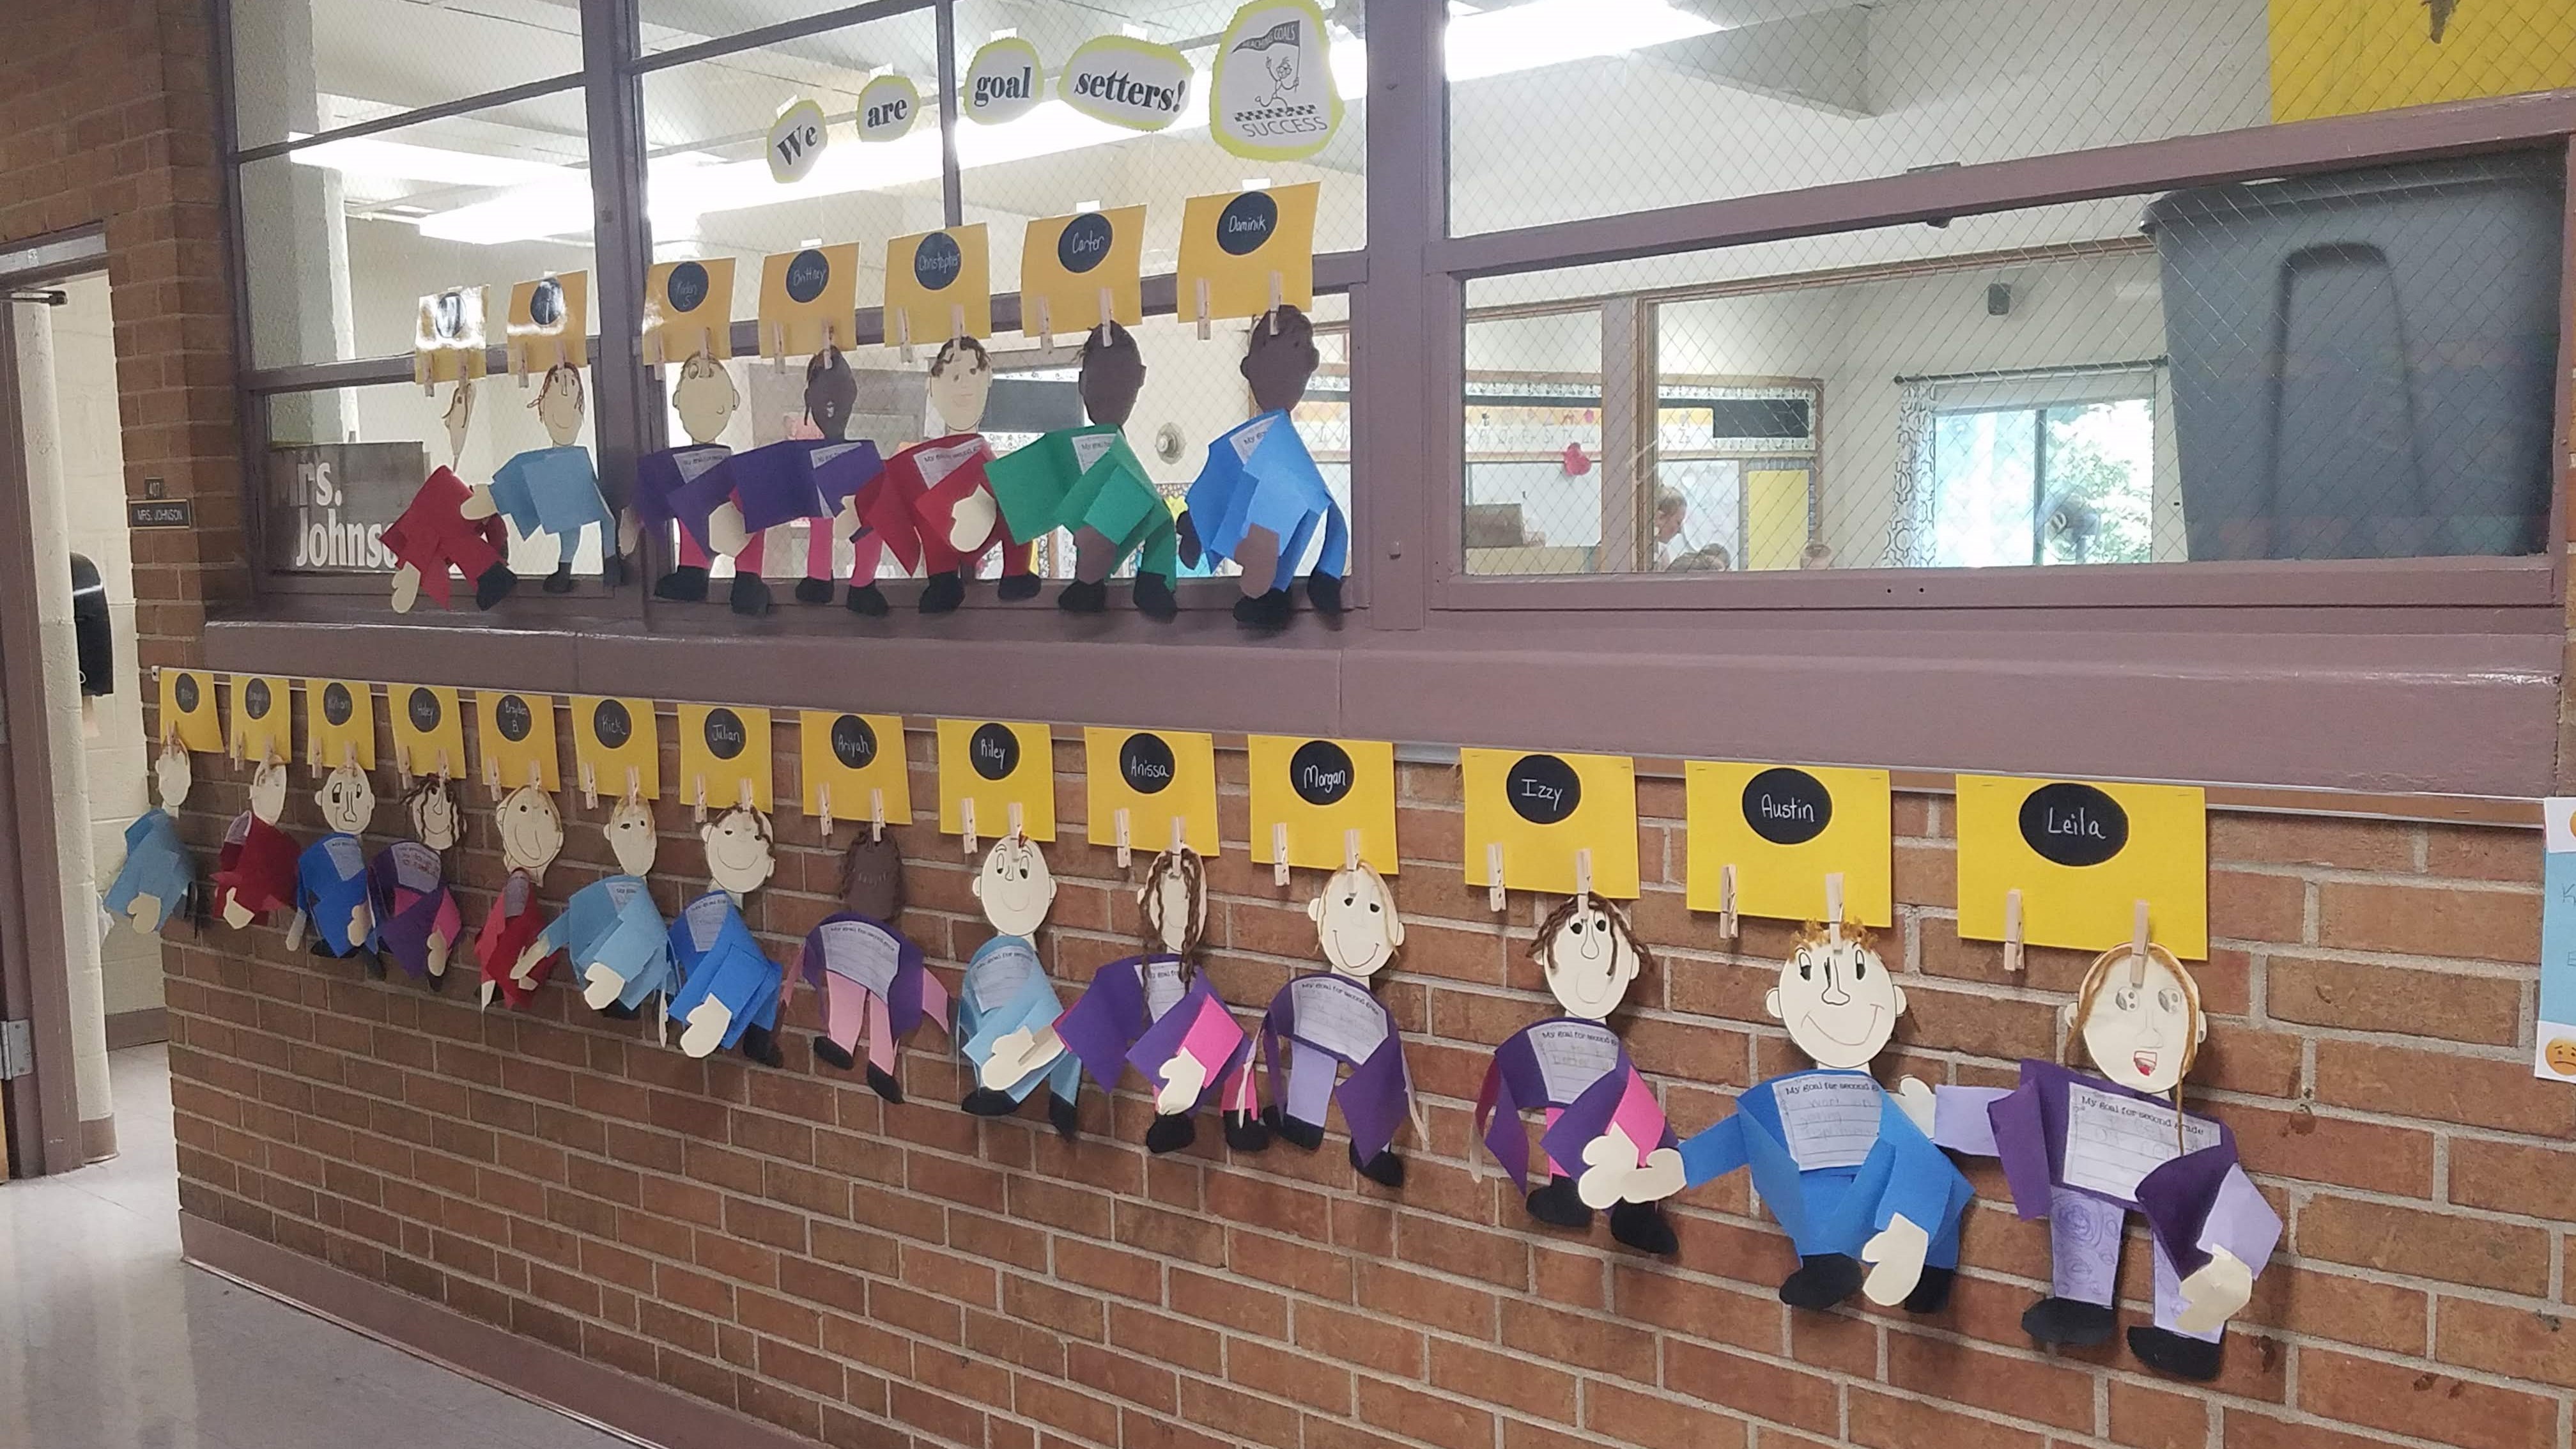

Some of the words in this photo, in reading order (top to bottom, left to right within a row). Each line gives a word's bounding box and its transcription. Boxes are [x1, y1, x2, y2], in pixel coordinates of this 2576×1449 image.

[1274, 25, 1295, 42] GOALS
[776, 124, 818, 166] We
[867, 99, 907, 128] are
[974, 66, 1031, 107] goal
[1074, 70, 1185, 112] setters!
[1242, 117, 1329, 138] SUCCESS
[1229, 213, 1267, 233] Dominik
[1072, 230, 1104, 254] Carter
[137, 509, 153, 520] MRS.
[155, 509, 183, 521] JOHNSON
[713, 724, 740, 742] Julian
[981, 738, 1005, 769] Riley
[1130, 755, 1169, 777] Anissa
[1304, 765, 1345, 793] Morgan
[1522, 779, 1562, 810] Izzy
[1761, 794, 1814, 822] Austin
[2048, 807, 2106, 839] Leila
[1785, 1086, 1800, 1096] My
[1803, 1081, 1823, 1093] goal
[1824, 1081, 1837, 1090] for
[2081, 1096, 2097, 1110] My
[2098, 1100, 2118, 1113] goal
[2121, 1106, 2137, 1117] for
[2138, 1111, 2171, 1127] second
[2174, 1120, 2204, 1136] grade
